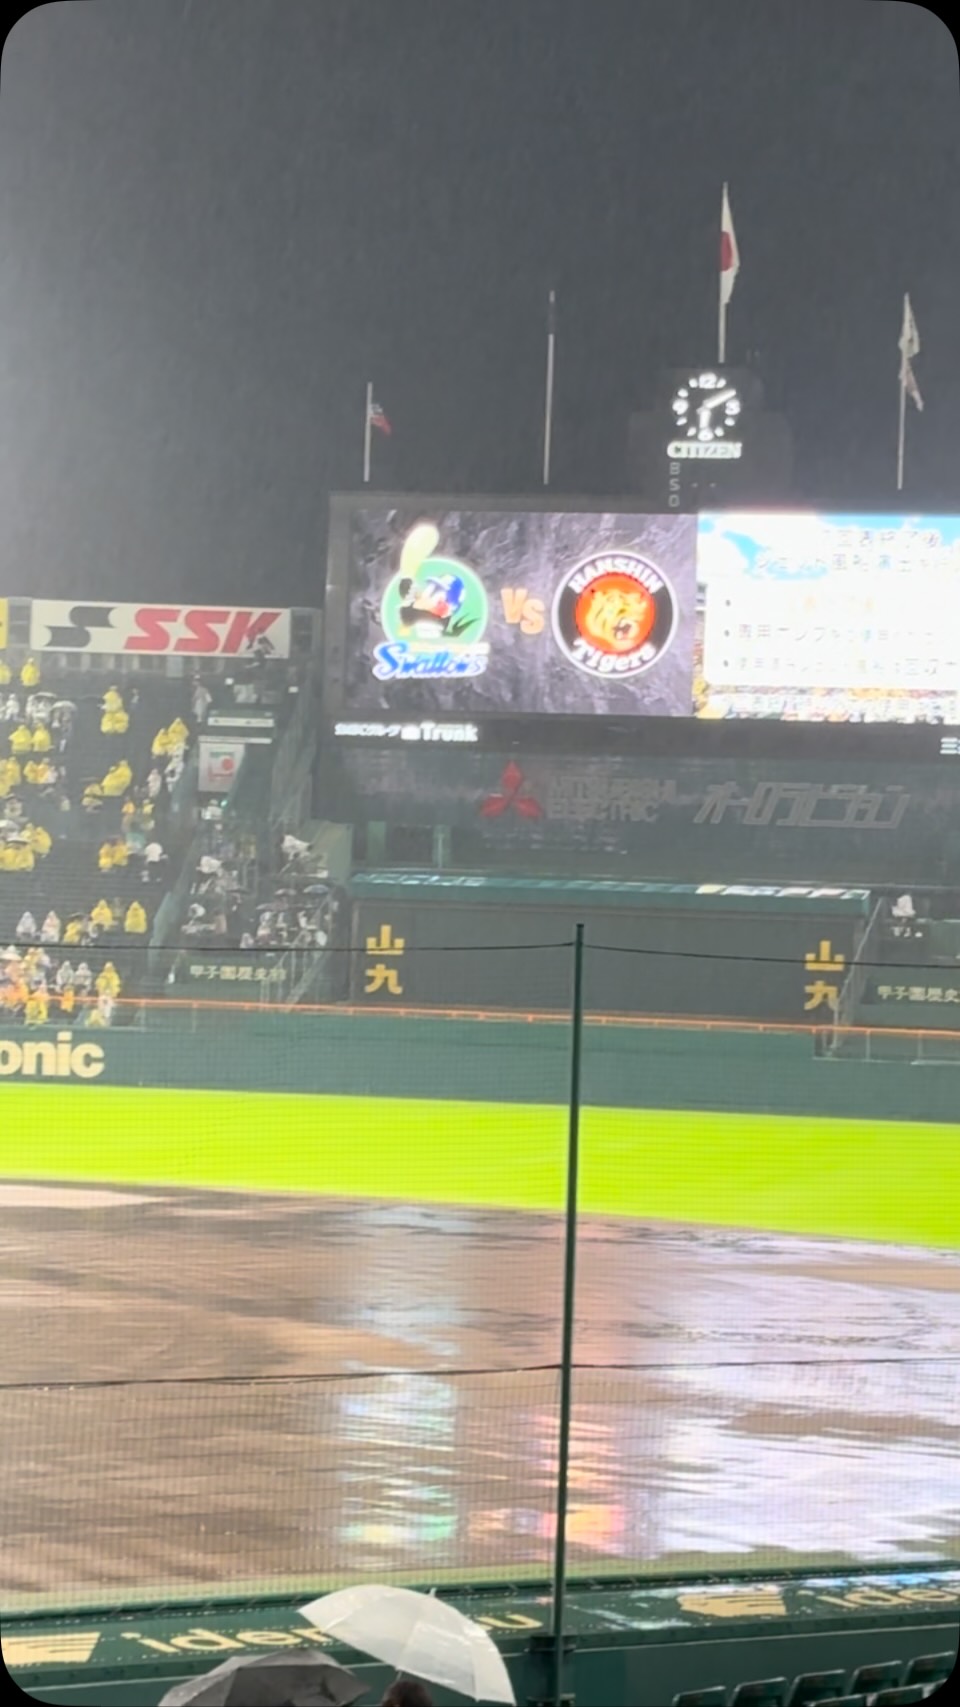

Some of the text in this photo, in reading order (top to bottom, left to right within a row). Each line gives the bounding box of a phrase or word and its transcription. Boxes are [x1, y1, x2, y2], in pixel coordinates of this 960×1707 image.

[667, 441, 742, 459] CITIZEN
[669, 478, 681, 491] S
[572, 556, 664, 594] HANSHIN
[124, 606, 284, 655] SSK
[372, 642, 488, 679] Swallows
[571, 637, 656, 673] Tigers
[365, 923, 405, 995] 山九
[803, 939, 846, 1012] 山九
[0, 1031, 104, 1079] onic
[796, 1586, 960, 1609] ide
